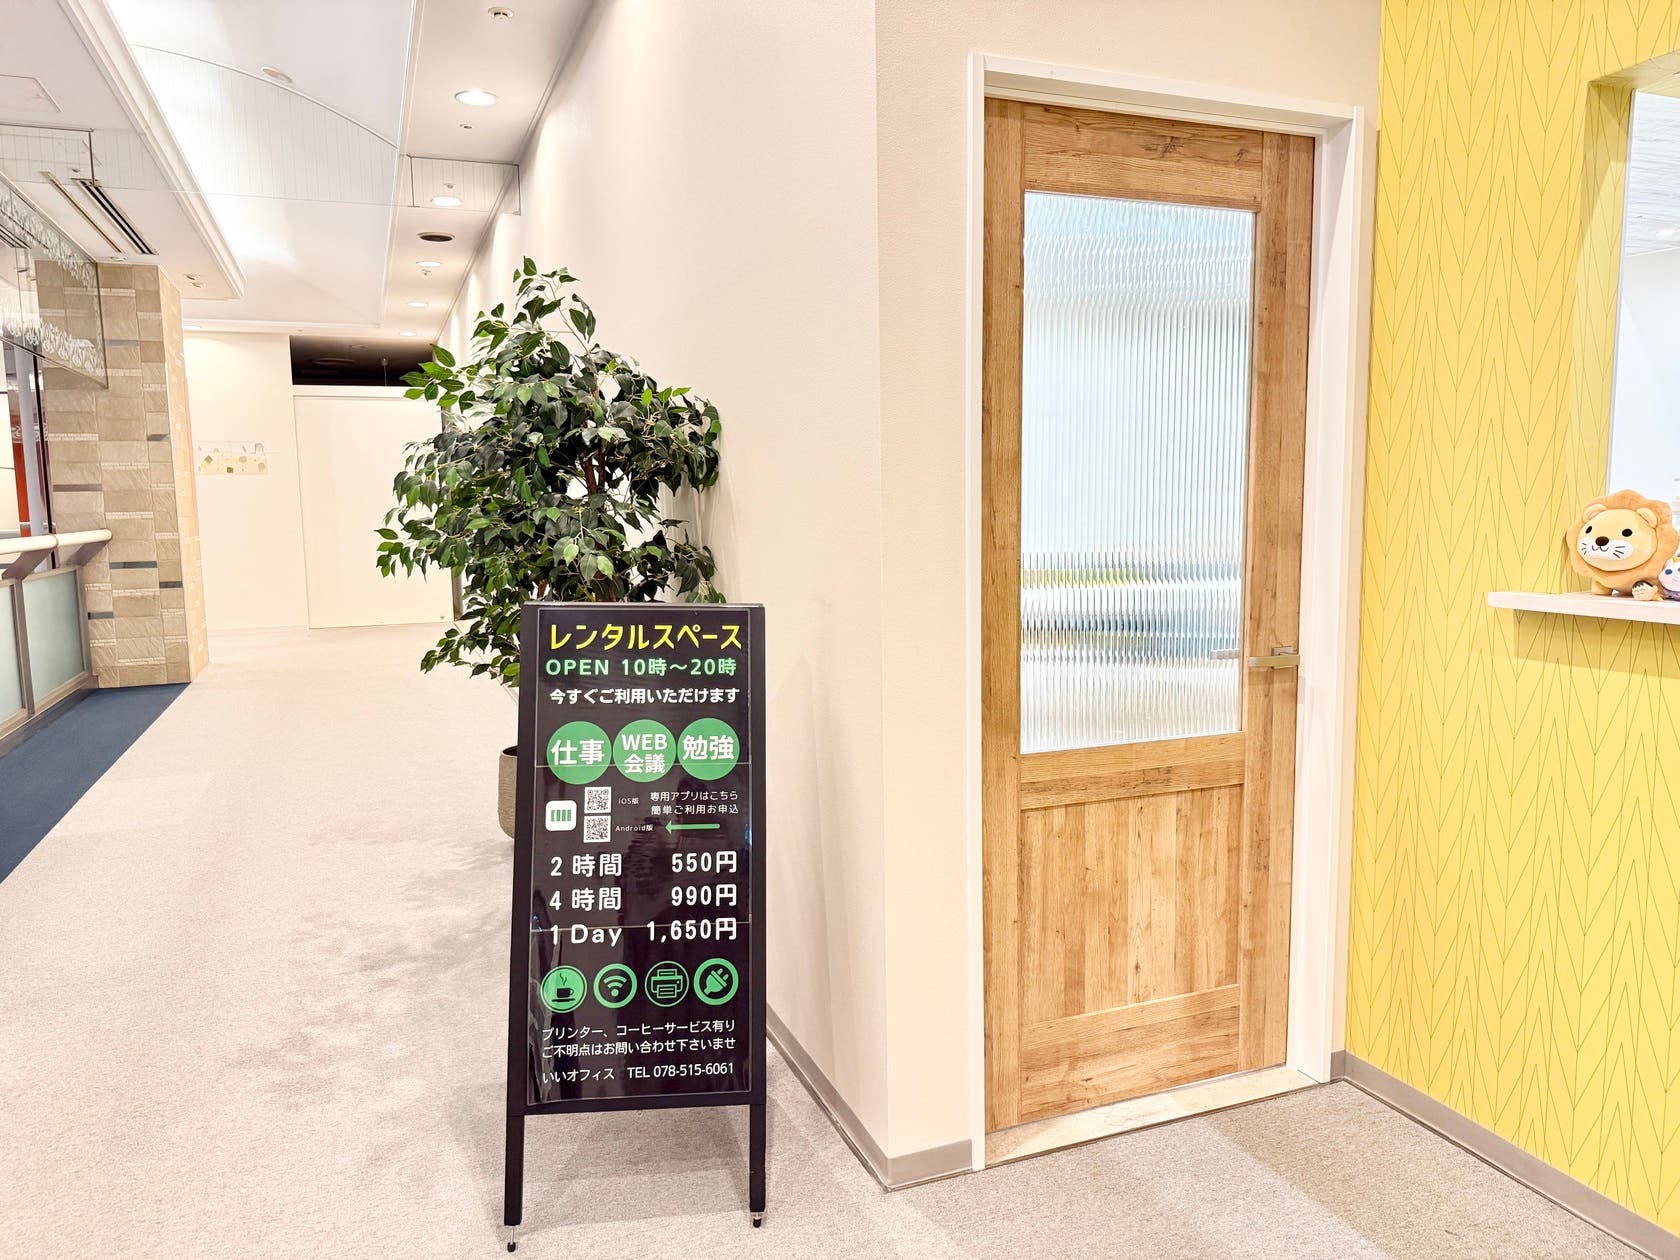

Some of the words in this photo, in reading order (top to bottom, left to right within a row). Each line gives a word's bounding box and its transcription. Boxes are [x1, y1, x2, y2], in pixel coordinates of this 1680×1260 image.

[550, 623, 742, 651] レンタルスペース
[545, 659, 610, 677] OPEN
[549, 688, 740, 705] 今すぐご利用いただけます
[551, 738, 606, 766] 仕事
[621, 734, 669, 751] WEB
[682, 734, 735, 761] 勉強
[624, 753, 667, 775] 会議
[650, 790, 739, 802] 専用アプリはこちら
[650, 804, 739, 816] 簡単ご利用お申込
[550, 856, 563, 877] 2
[572, 853, 623, 878] 時間
[671, 850, 738, 873] 550円
[549, 890, 562, 911] 4
[571, 886, 622, 912] 時間
[671, 883, 738, 906] 990円
[550, 924, 559, 945] 1
[571, 924, 623, 948] Day
[646, 917, 738, 943] 1,650円
[541, 1019, 736, 1041] プリンター、コーヒーサービス有り
[542, 1037, 737, 1059] ご不明点はお問い合わせ下さいませ
[542, 1066, 615, 1084] いいオフィス
[627, 1066, 651, 1079] TEL
[653, 1063, 734, 1078] 078-515-6061
